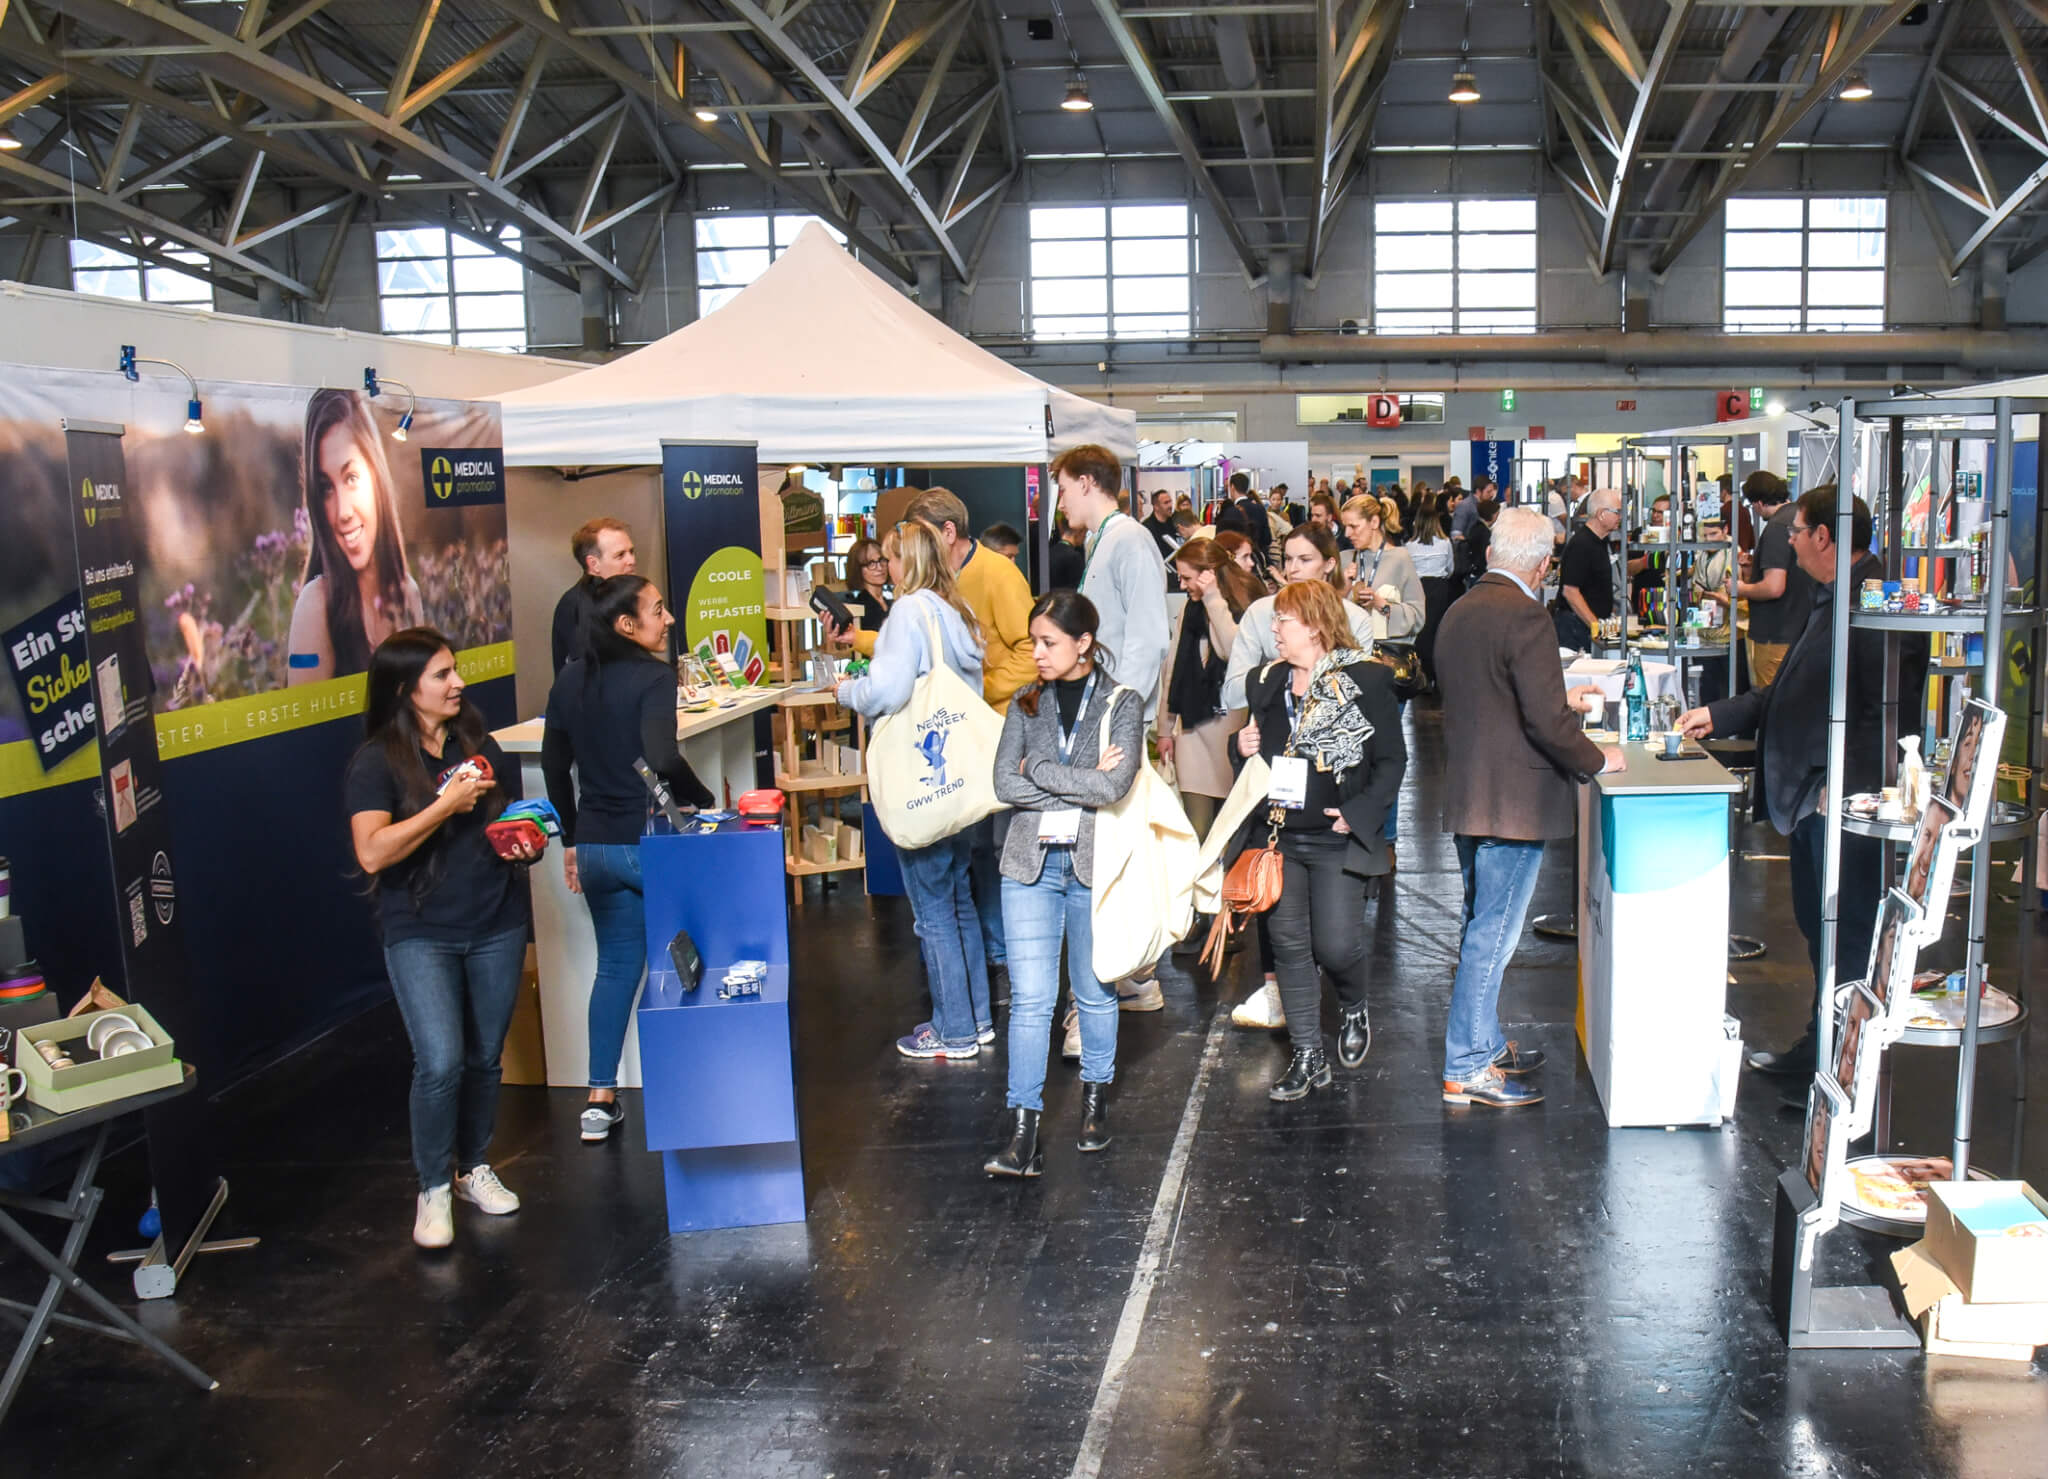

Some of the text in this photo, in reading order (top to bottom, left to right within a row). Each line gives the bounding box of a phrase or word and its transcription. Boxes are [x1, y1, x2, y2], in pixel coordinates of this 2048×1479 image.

[1376, 399, 1391, 418] D
[1726, 395, 1741, 415] C
[454, 462, 496, 476] MEDICAL
[704, 474, 743, 485] MEDICAL
[95, 483, 121, 501] MEDICAL
[705, 487, 744, 497] promotion
[708, 570, 752, 583] COOLE
[700, 605, 761, 620] PFLASTER
[11, 631, 57, 672] Ein
[157, 724, 205, 748] STER
[246, 702, 301, 728] ERSTE
[309, 690, 357, 713] HILFE
[934, 711, 968, 730] WEEK
[906, 777, 965, 810] GWW TREND
